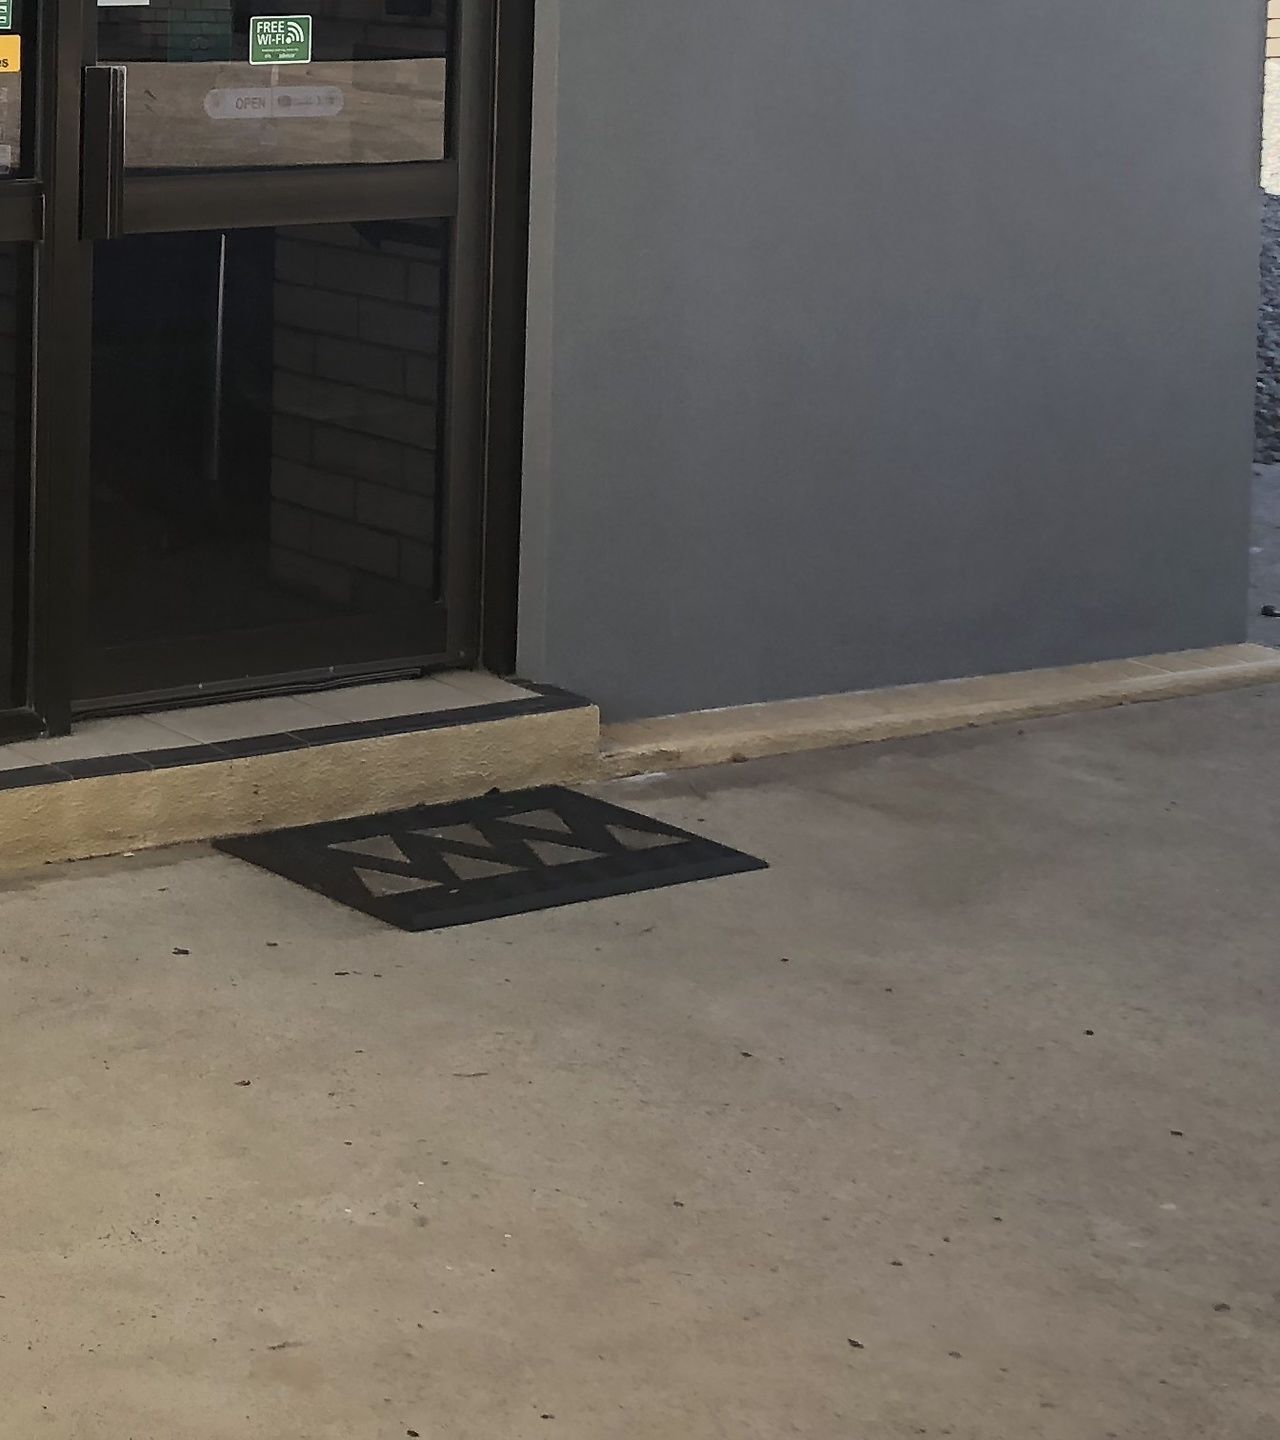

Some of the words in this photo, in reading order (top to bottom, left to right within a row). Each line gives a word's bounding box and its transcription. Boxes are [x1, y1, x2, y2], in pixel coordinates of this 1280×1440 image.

[256, 21, 285, 33] FREE
[256, 33, 285, 46] WI-FI
[235, 96, 266, 110] OPEN
